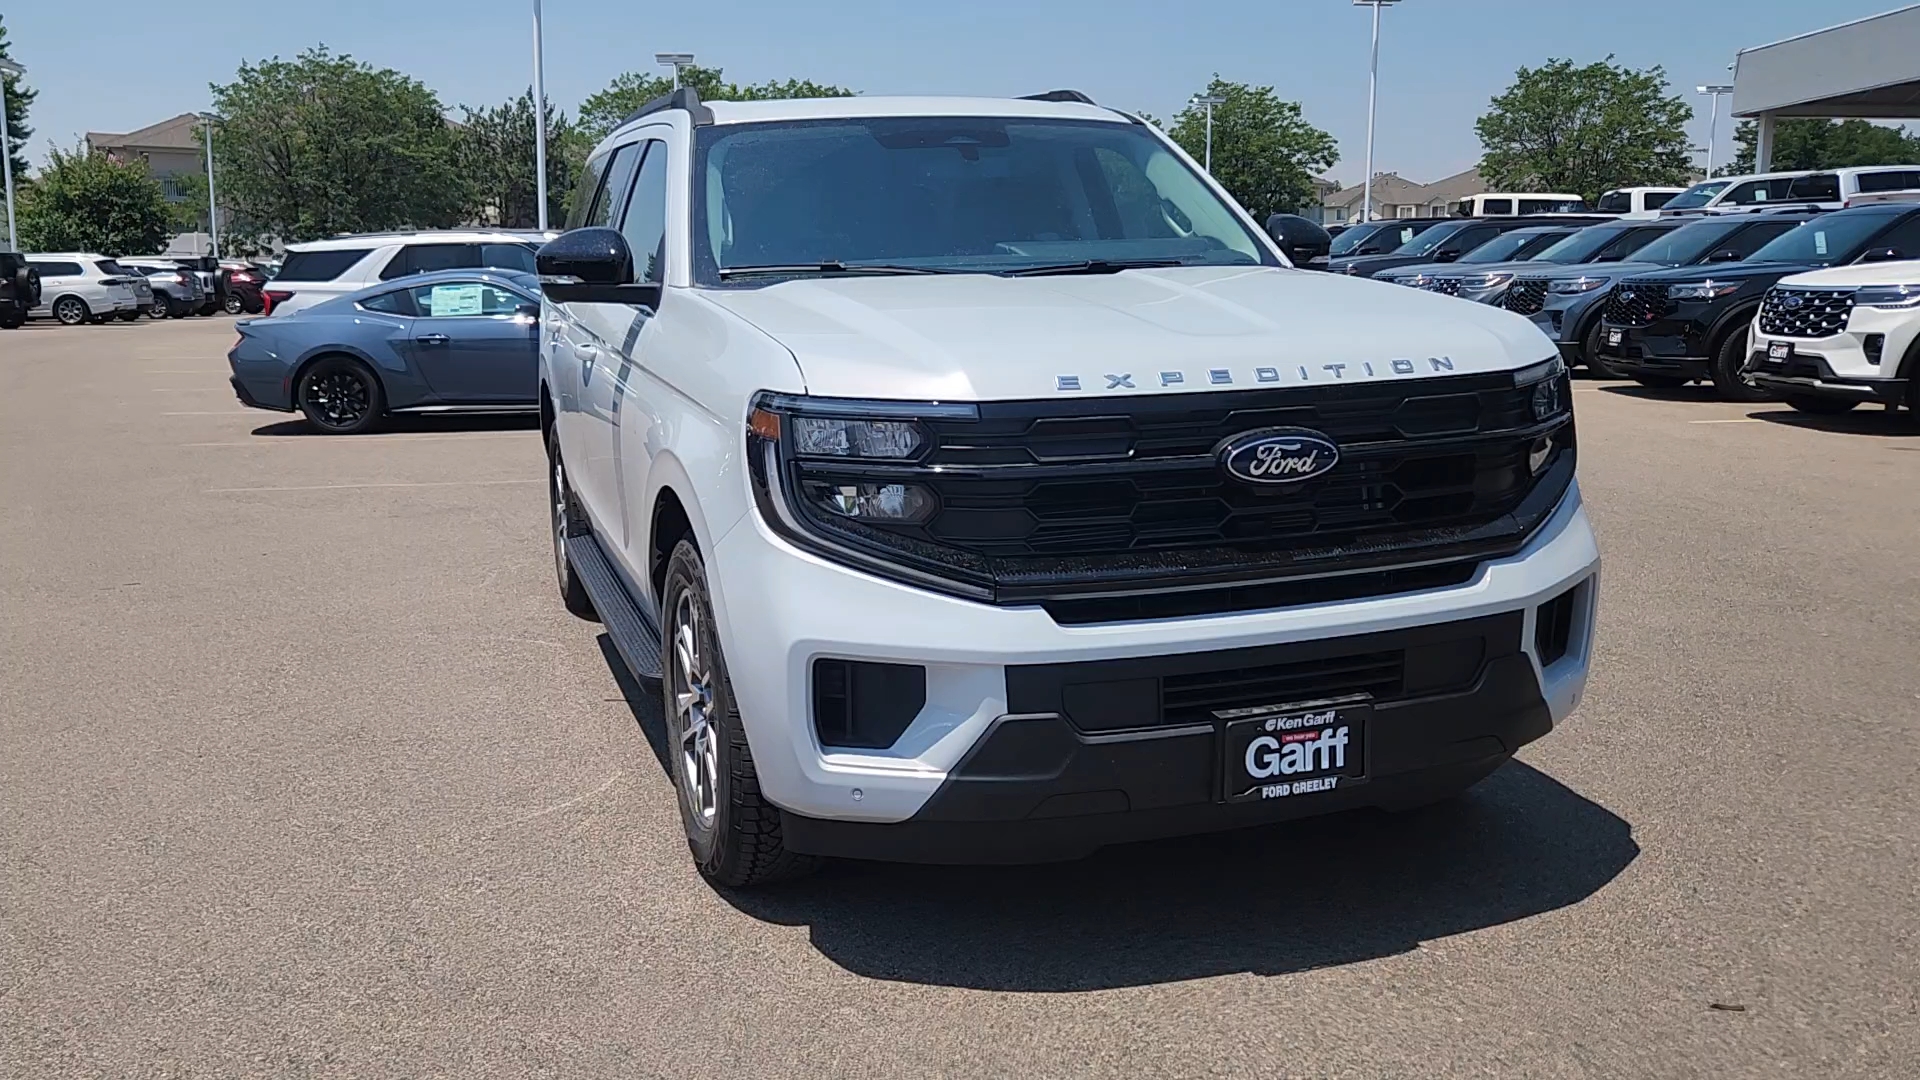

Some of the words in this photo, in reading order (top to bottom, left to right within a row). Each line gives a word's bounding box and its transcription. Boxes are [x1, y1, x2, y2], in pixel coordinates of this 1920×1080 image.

[1054, 356, 1455, 391] EXPEDITION
[1249, 443, 1317, 476] Ford
[1277, 715, 1302, 730] Ken
[1303, 711, 1335, 727] Garff
[1245, 726, 1348, 779] Garff
[1262, 782, 1290, 799] FORD
[1292, 777, 1338, 794] GREELEY
